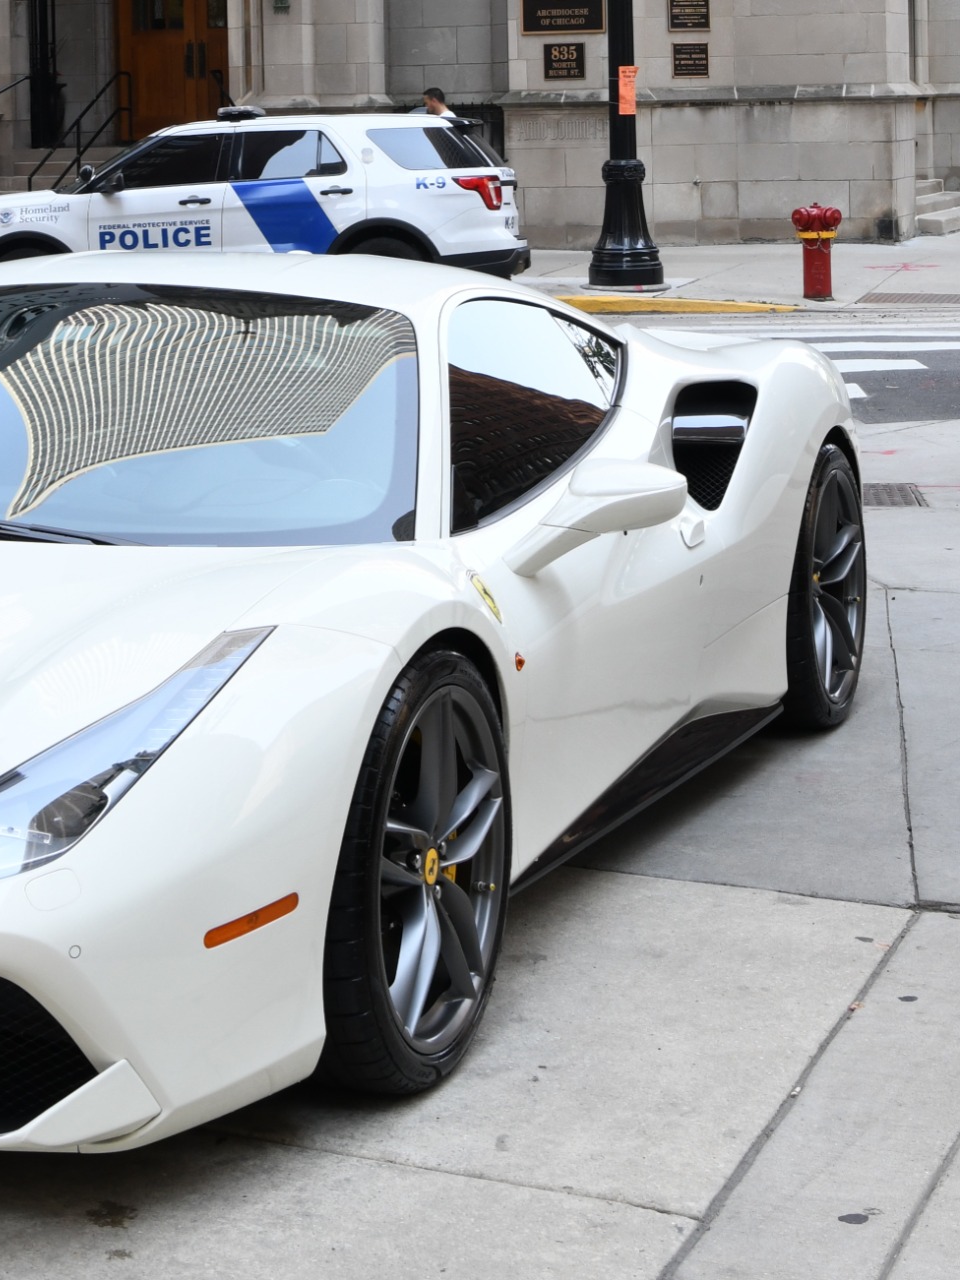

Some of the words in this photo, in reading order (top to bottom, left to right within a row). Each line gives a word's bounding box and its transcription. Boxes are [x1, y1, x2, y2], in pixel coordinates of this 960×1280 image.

[536, 7, 589, 17] ARCHDIOCESE
[541, 18, 551, 26] OF
[552, 17, 585, 26] CHICAGO
[551, 46, 577, 60] 835
[552, 61, 576, 69] NORTH
[548, 69, 568, 77] RUSH
[415, 176, 446, 190] K-9
[20, 203, 70, 216] Homeland
[19, 214, 60, 224] Security
[132, 221, 178, 229] PROTECTIVE
[179, 219, 211, 227] SERVICE
[98, 226, 212, 250] POLICE
